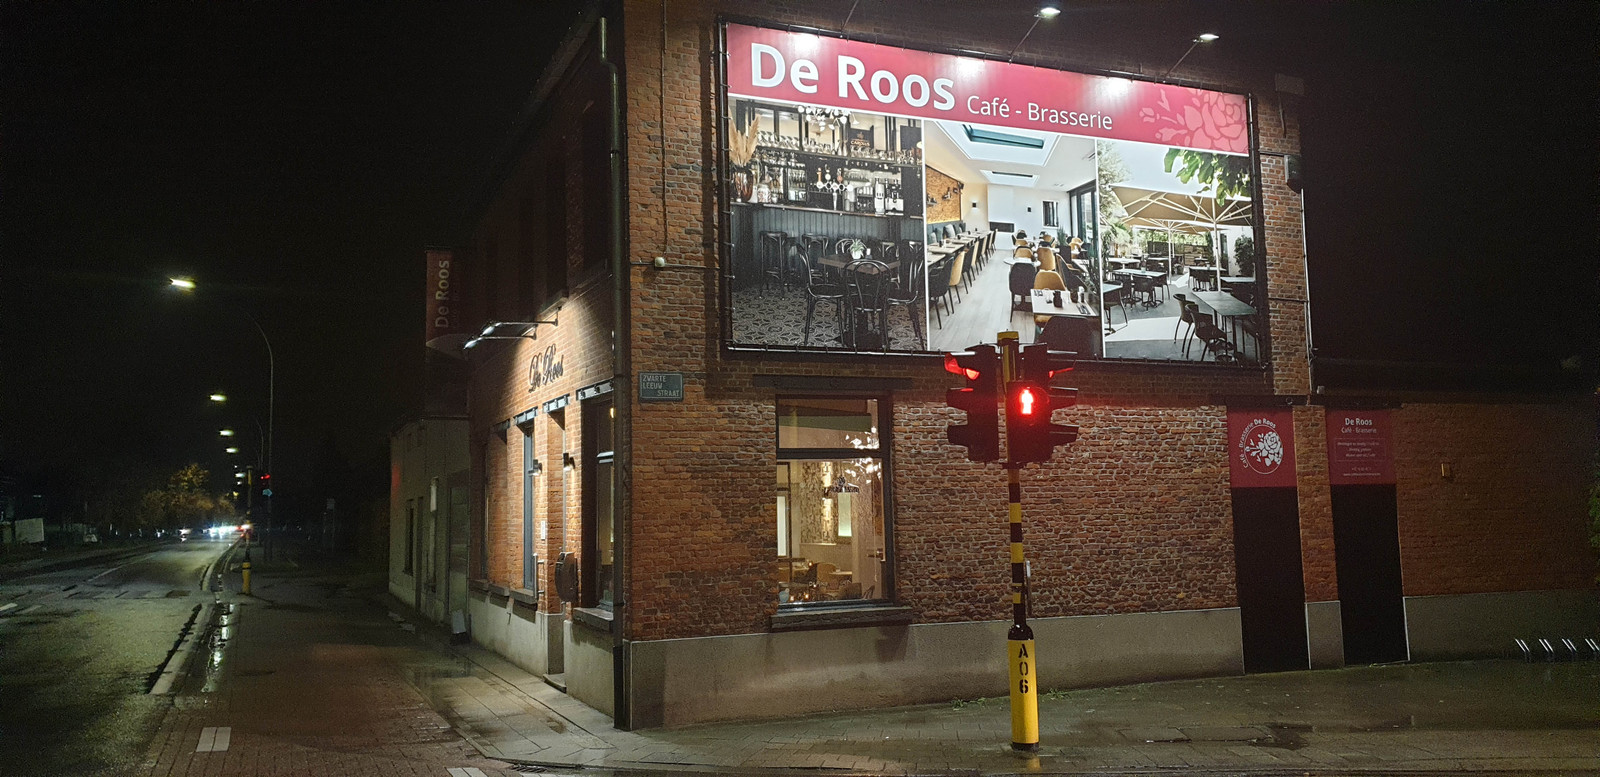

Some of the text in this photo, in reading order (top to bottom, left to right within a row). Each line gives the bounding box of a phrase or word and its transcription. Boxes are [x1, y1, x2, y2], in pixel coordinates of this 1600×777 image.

[751, 42, 956, 111] De Roos
[967, 95, 1010, 118] Café
[1028, 102, 1113, 130] Brasserie
[435, 260, 450, 328] De Roos
[528, 343, 564, 393] De Roos
[642, 382, 664, 390] LEEUW
[657, 389, 680, 397] STRAAT
[1262, 418, 1276, 429] Roos
[1344, 417, 1373, 426] De Roos
[1238, 422, 1254, 448] Brasserie
[1239, 453, 1249, 469] Café
[1018, 643, 1029, 694] A06
